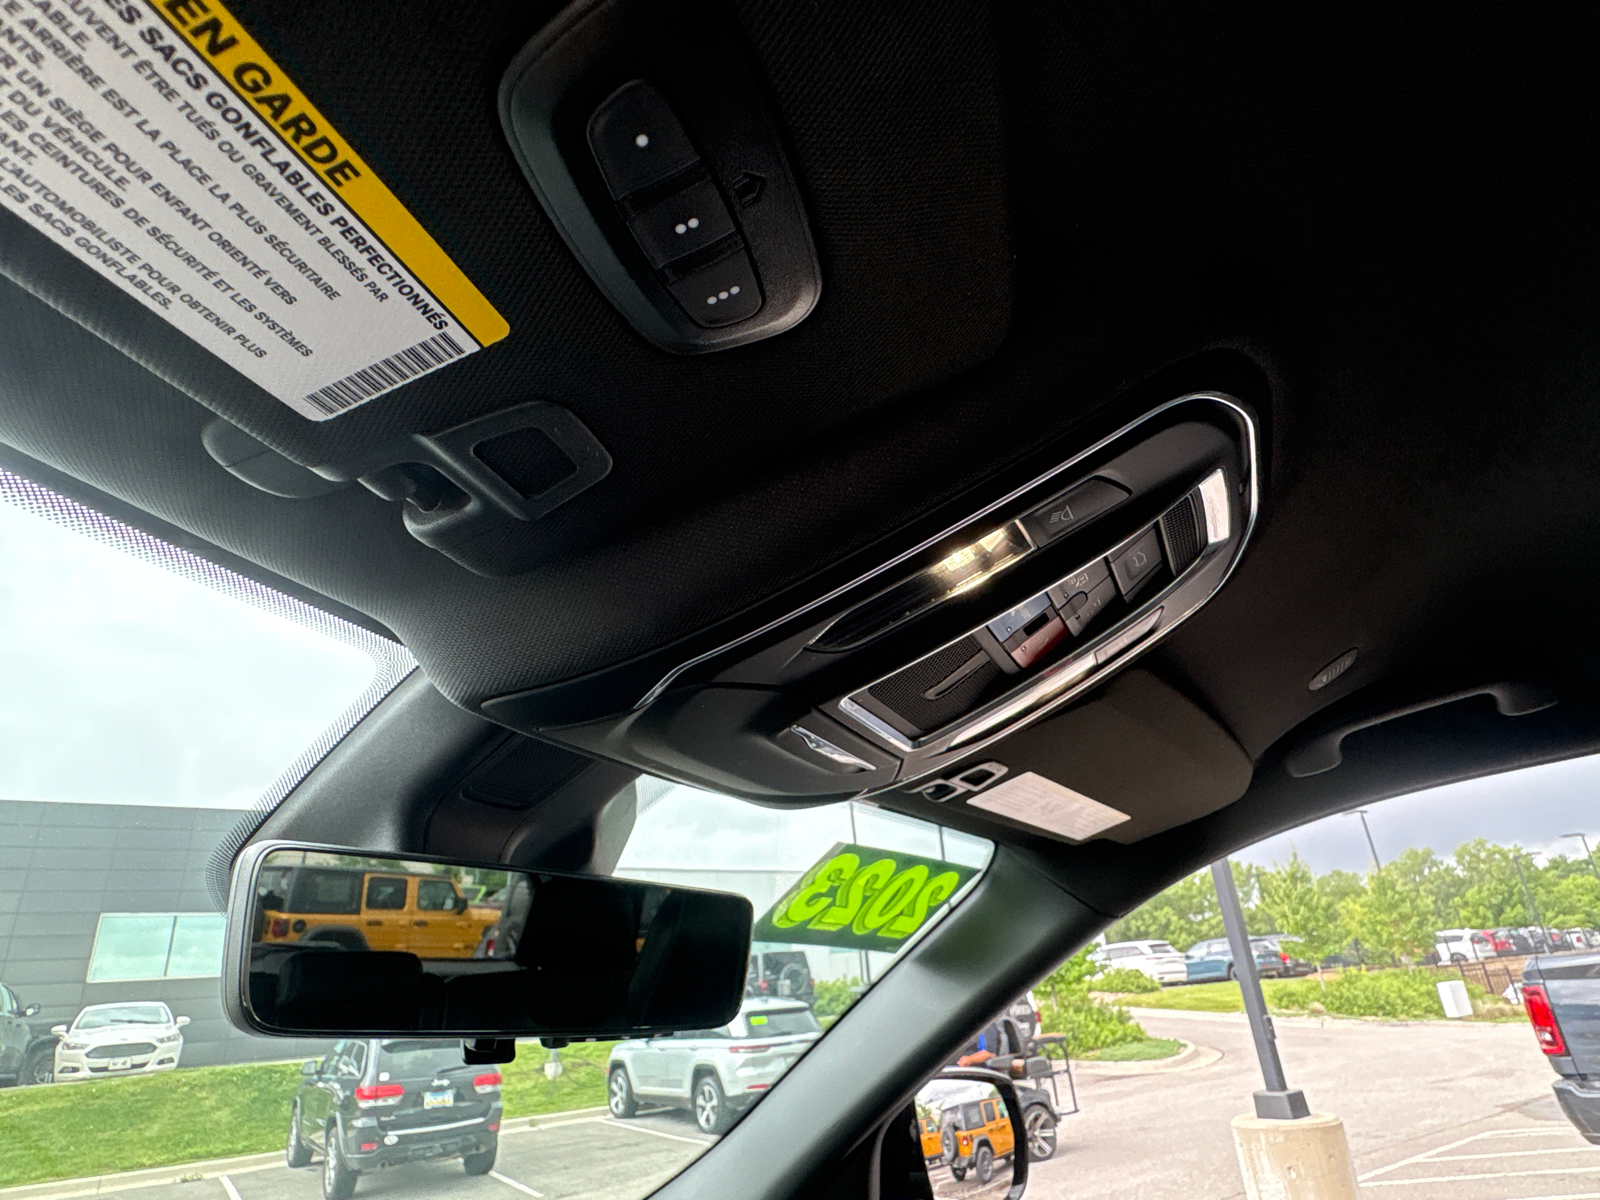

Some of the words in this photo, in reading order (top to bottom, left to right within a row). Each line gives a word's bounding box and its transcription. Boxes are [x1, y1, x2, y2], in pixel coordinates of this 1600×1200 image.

[8, 90, 43, 117] DU
[16, 68, 51, 98] UN
[48, 97, 107, 143] SIÈGE
[102, 142, 153, 184] POUR
[149, 182, 212, 231] ENFANT
[207, 231, 270, 280] ORIENTÉ
[263, 276, 298, 305] VERS
[19, 18, 107, 91] ARRIÈRE
[101, 88, 141, 118] EST
[135, 118, 161, 141] LA
[159, 140, 213, 186] PLACE
[208, 183, 231, 204] LA
[228, 201, 268, 235] PLUS
[264, 233, 341, 301] SÉCURITAIRE
[62, 0, 139, 59] UVENT
[132, 59, 182, 102] ÊTRE
[177, 100, 220, 141] TUÉS
[217, 140, 245, 163] OU
[241, 162, 323, 236] GRAVEMENT
[317, 235, 368, 282] BLESSÉS
[363, 280, 389, 303] PAR
[139, 26, 209, 90] SACS
[205, 91, 335, 216] GONFLABLES
[329, 215, 449, 331] PERFECTIONNÉS
[233, 61, 362, 188] GARDE
[0, 156, 142, 265] L'AUTOMOBILISTE
[138, 262, 182, 295] POUR
[179, 293, 237, 336] OBTENIR
[233, 333, 268, 358] PLUS
[28, 132, 126, 209] CEINTURES
[122, 207, 151, 228] DE
[146, 226, 220, 281] SÉCURITÉ
[212, 278, 235, 293] ET
[229, 292, 257, 313] LES
[254, 311, 314, 358] SYSTÈMES
[28, 202, 76, 237] SACS
[74, 236, 173, 310] GONFLABLES.
